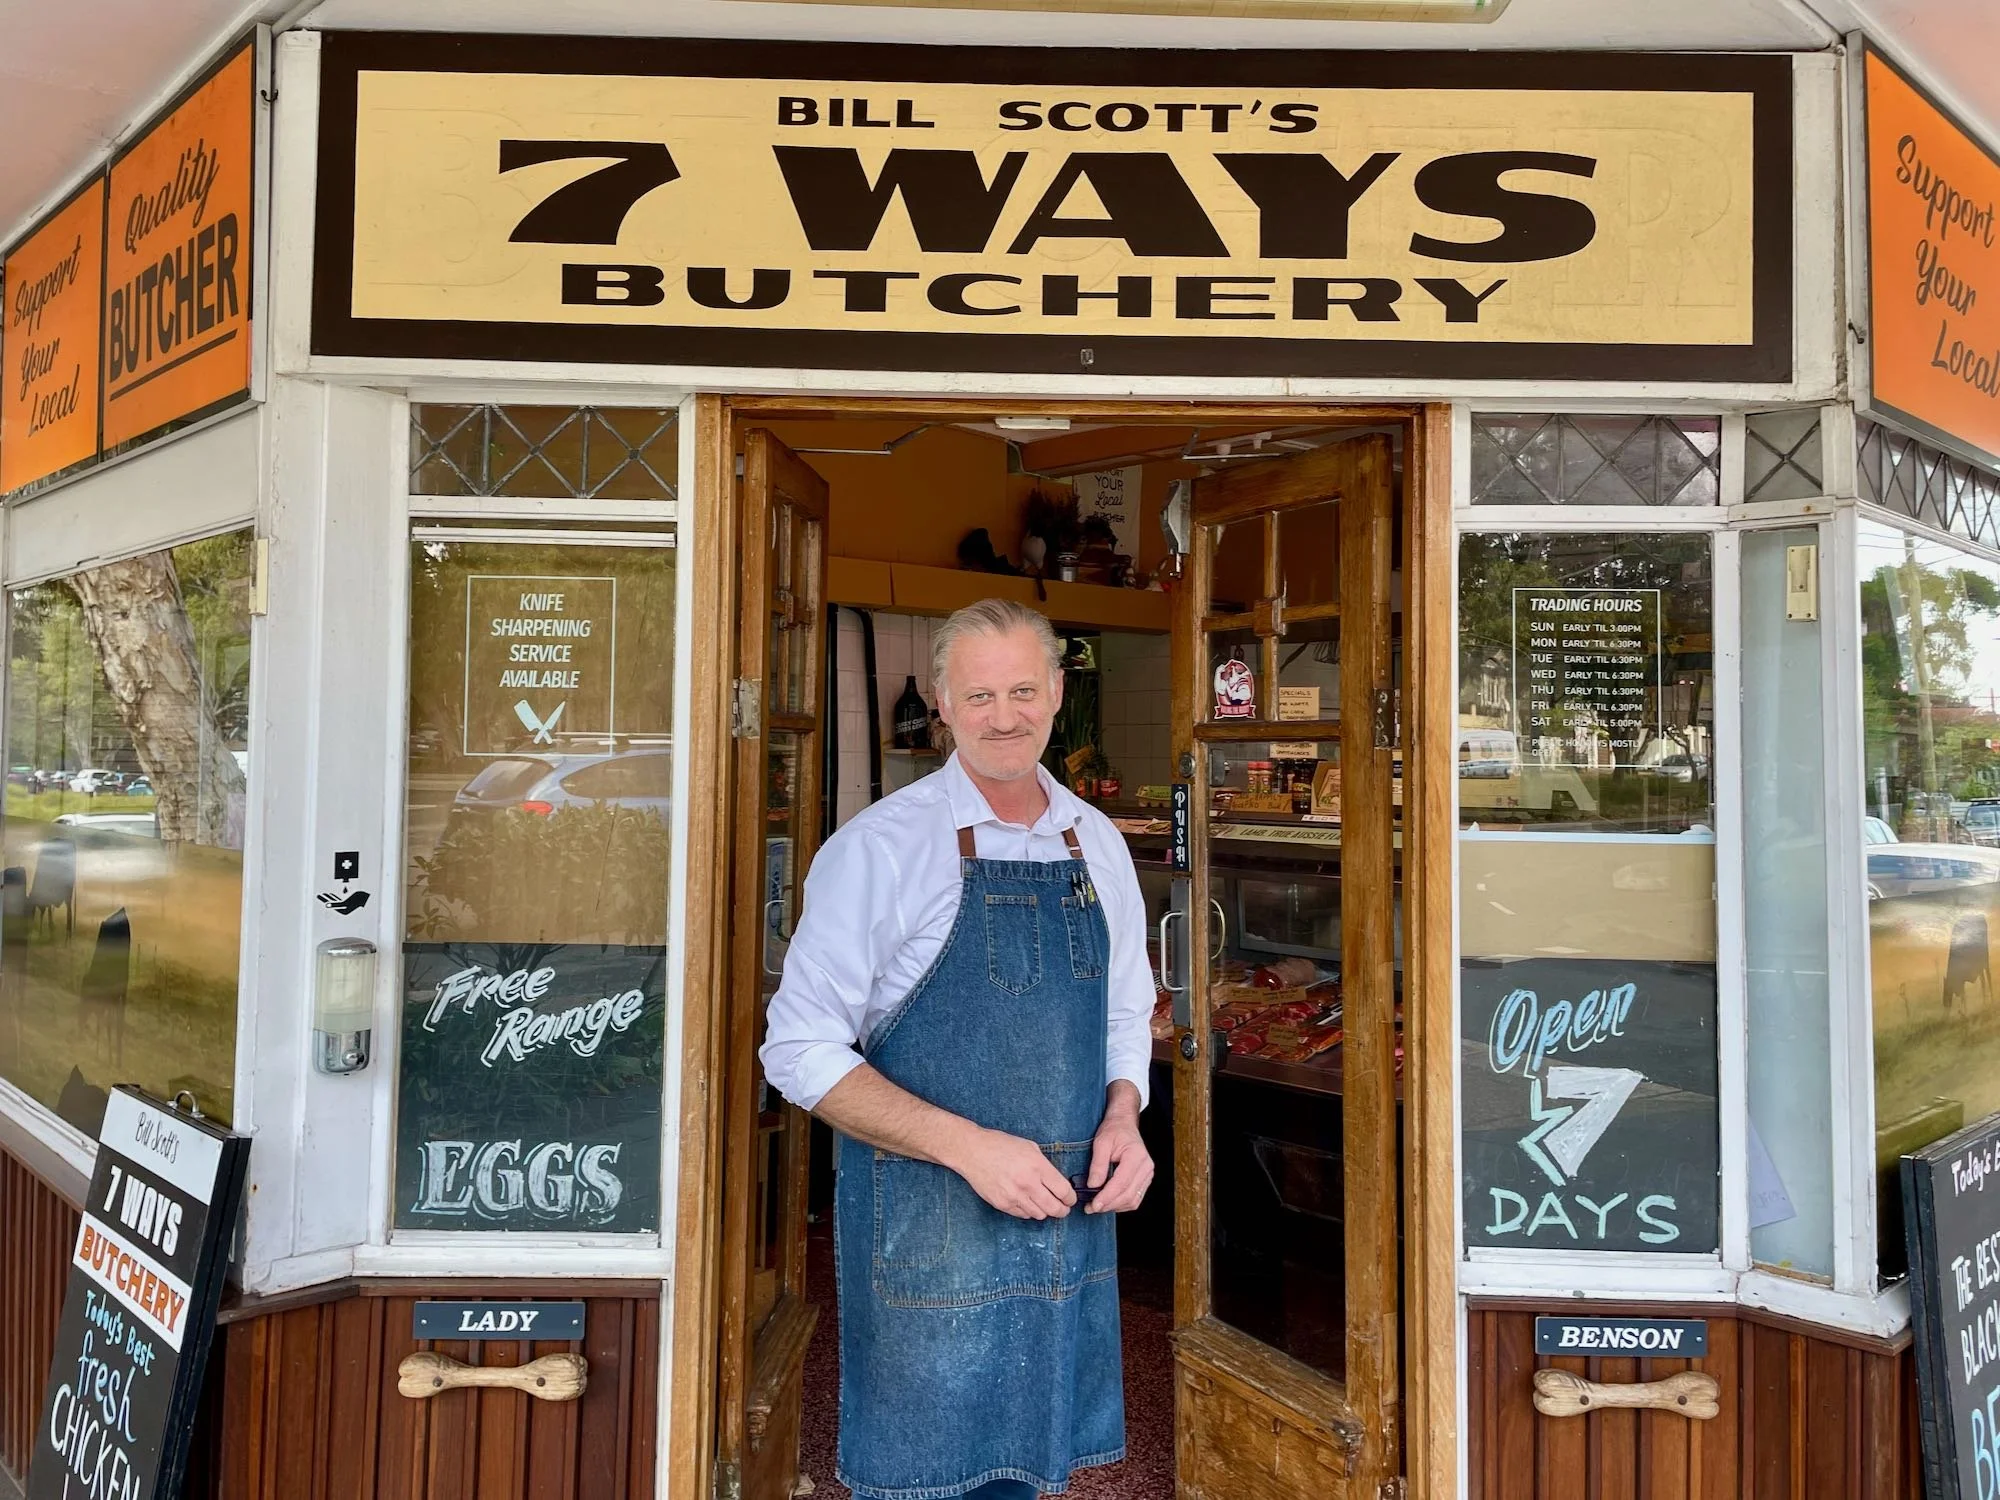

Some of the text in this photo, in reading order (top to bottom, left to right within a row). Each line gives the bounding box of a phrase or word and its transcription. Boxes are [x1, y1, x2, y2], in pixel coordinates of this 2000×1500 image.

[777, 96, 1319, 134] BILL SCOTT'S
[125, 138, 220, 255] Quality
[498, 139, 1598, 263] 7 WAYS
[1896, 134, 1996, 249] Support
[14, 234, 82, 337] Support
[109, 213, 239, 384] BUTCHER
[561, 263, 1509, 323] BUTCHERY
[1916, 239, 1977, 316] Your
[20, 338, 61, 402] Your
[1931, 319, 2000, 399] Local
[28, 364, 80, 438] Local
[1094, 475, 1124, 492] YOUR
[1095, 491, 1124, 510] Local
[490, 617, 592, 638] SHARPENING
[519, 592, 565, 612] KNIFE
[1529, 598, 1643, 613] TRADING HOURS
[1530, 622, 1555, 632] SUN
[1562, 623, 1591, 633] EARLY
[508, 643, 573, 663] SERVICE
[1530, 637, 1557, 648] MON
[1562, 639, 1590, 648] EARLY
[1530, 653, 1553, 664] TUE
[1563, 655, 1592, 664] EARLY
[498, 669, 581, 689] AVAILABLE
[1530, 669, 1557, 679] WED
[1564, 671, 1593, 680] EARLY
[1531, 685, 1555, 695] THU
[1564, 687, 1593, 696] EARLY
[1531, 701, 1550, 711] FRI
[1563, 702, 1592, 711] EARLY
[1531, 717, 1552, 727] SAT
[1174, 790, 1186, 863] PUSH
[425, 965, 556, 1031] Free
[482, 988, 645, 1066] Range
[1490, 982, 1637, 1078] Open
[135, 1111, 181, 1164] Bill Scott's
[1543, 1066, 1644, 1178] 7
[413, 1139, 623, 1220] EGGS
[1951, 1148, 1991, 1197] Today's
[103, 1164, 183, 1257] 7 WAYS
[1486, 1187, 1680, 1244] DAYS
[79, 1224, 185, 1334] BUTCHERY
[1951, 1255, 1974, 1312] THE
[84, 1290, 156, 1376] Today's Best
[458, 1310, 539, 1332] LADY
[1558, 1326, 1684, 1350] BENSON
[77, 1329, 138, 1443] fresh
[50, 1383, 141, 1500] CHICKEN
